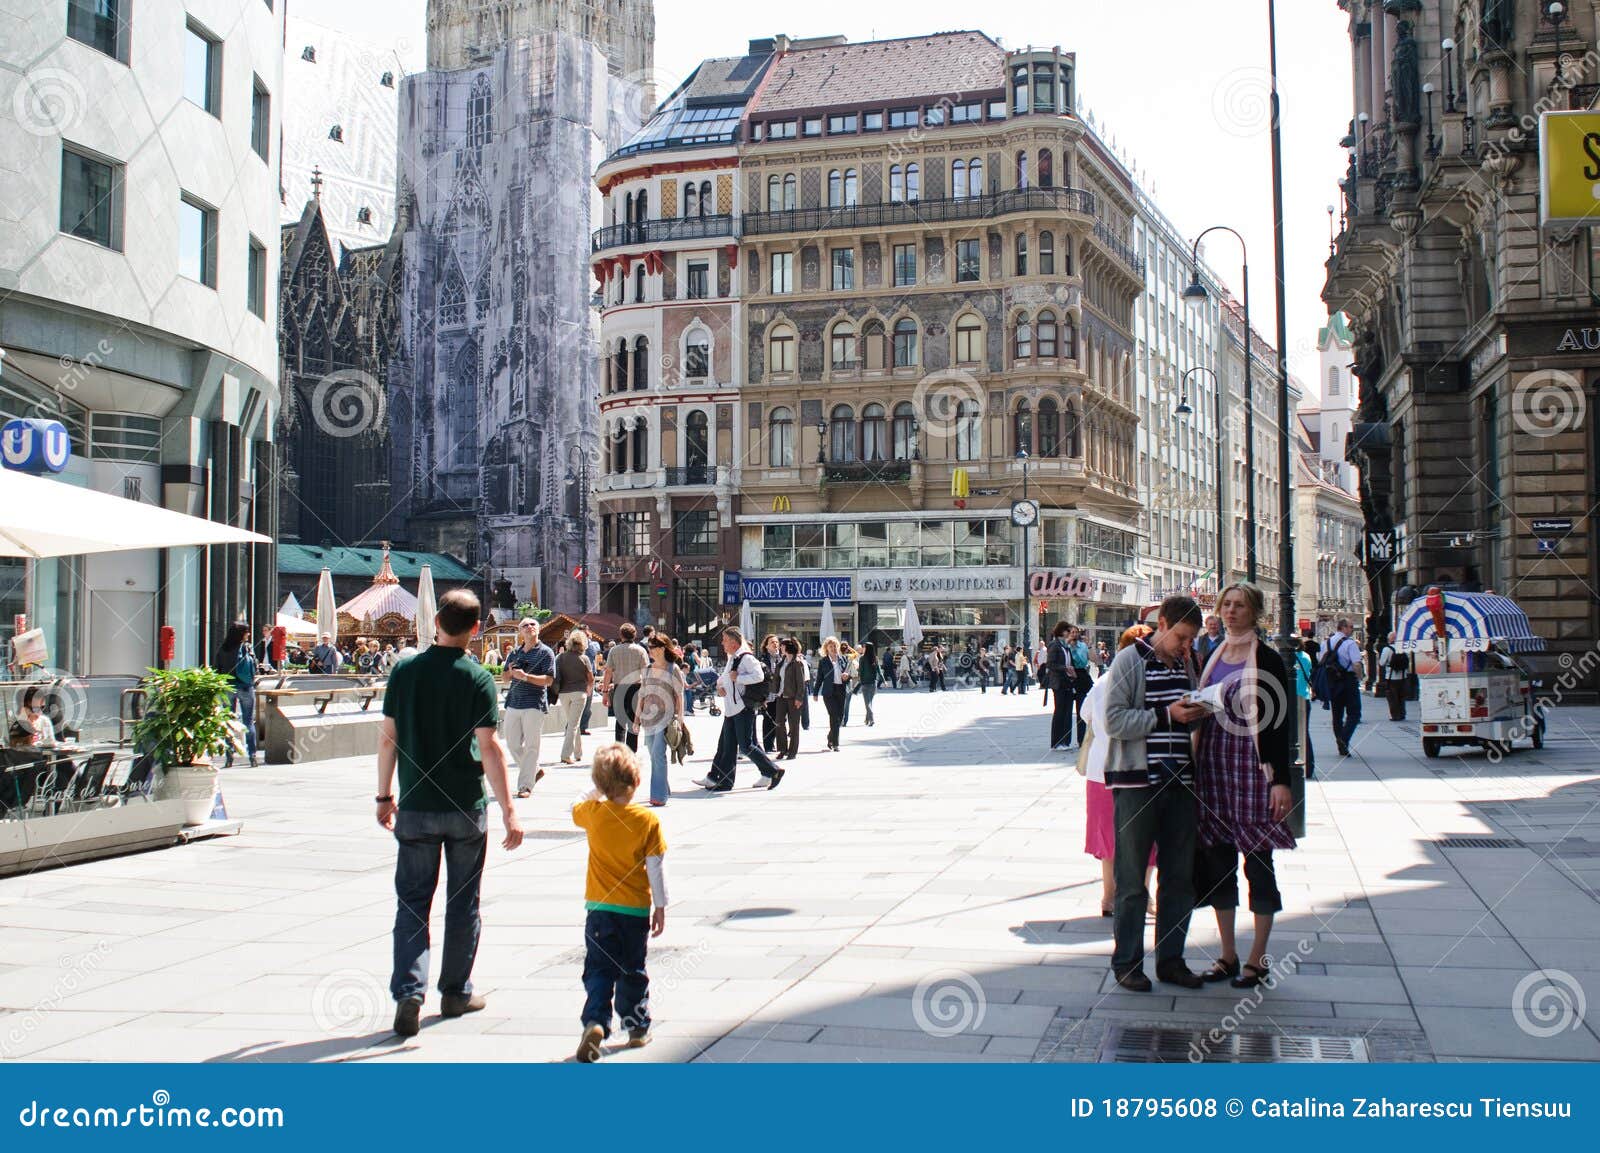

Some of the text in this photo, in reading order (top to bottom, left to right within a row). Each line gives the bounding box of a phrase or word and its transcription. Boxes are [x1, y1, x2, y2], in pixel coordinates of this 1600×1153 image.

[2, 429, 33, 464] U
[45, 429, 68, 466] U
[741, 581, 783, 598] MONEY
[787, 580, 851, 598] EXCHANGE
[1465, 640, 1482, 648] EIS
